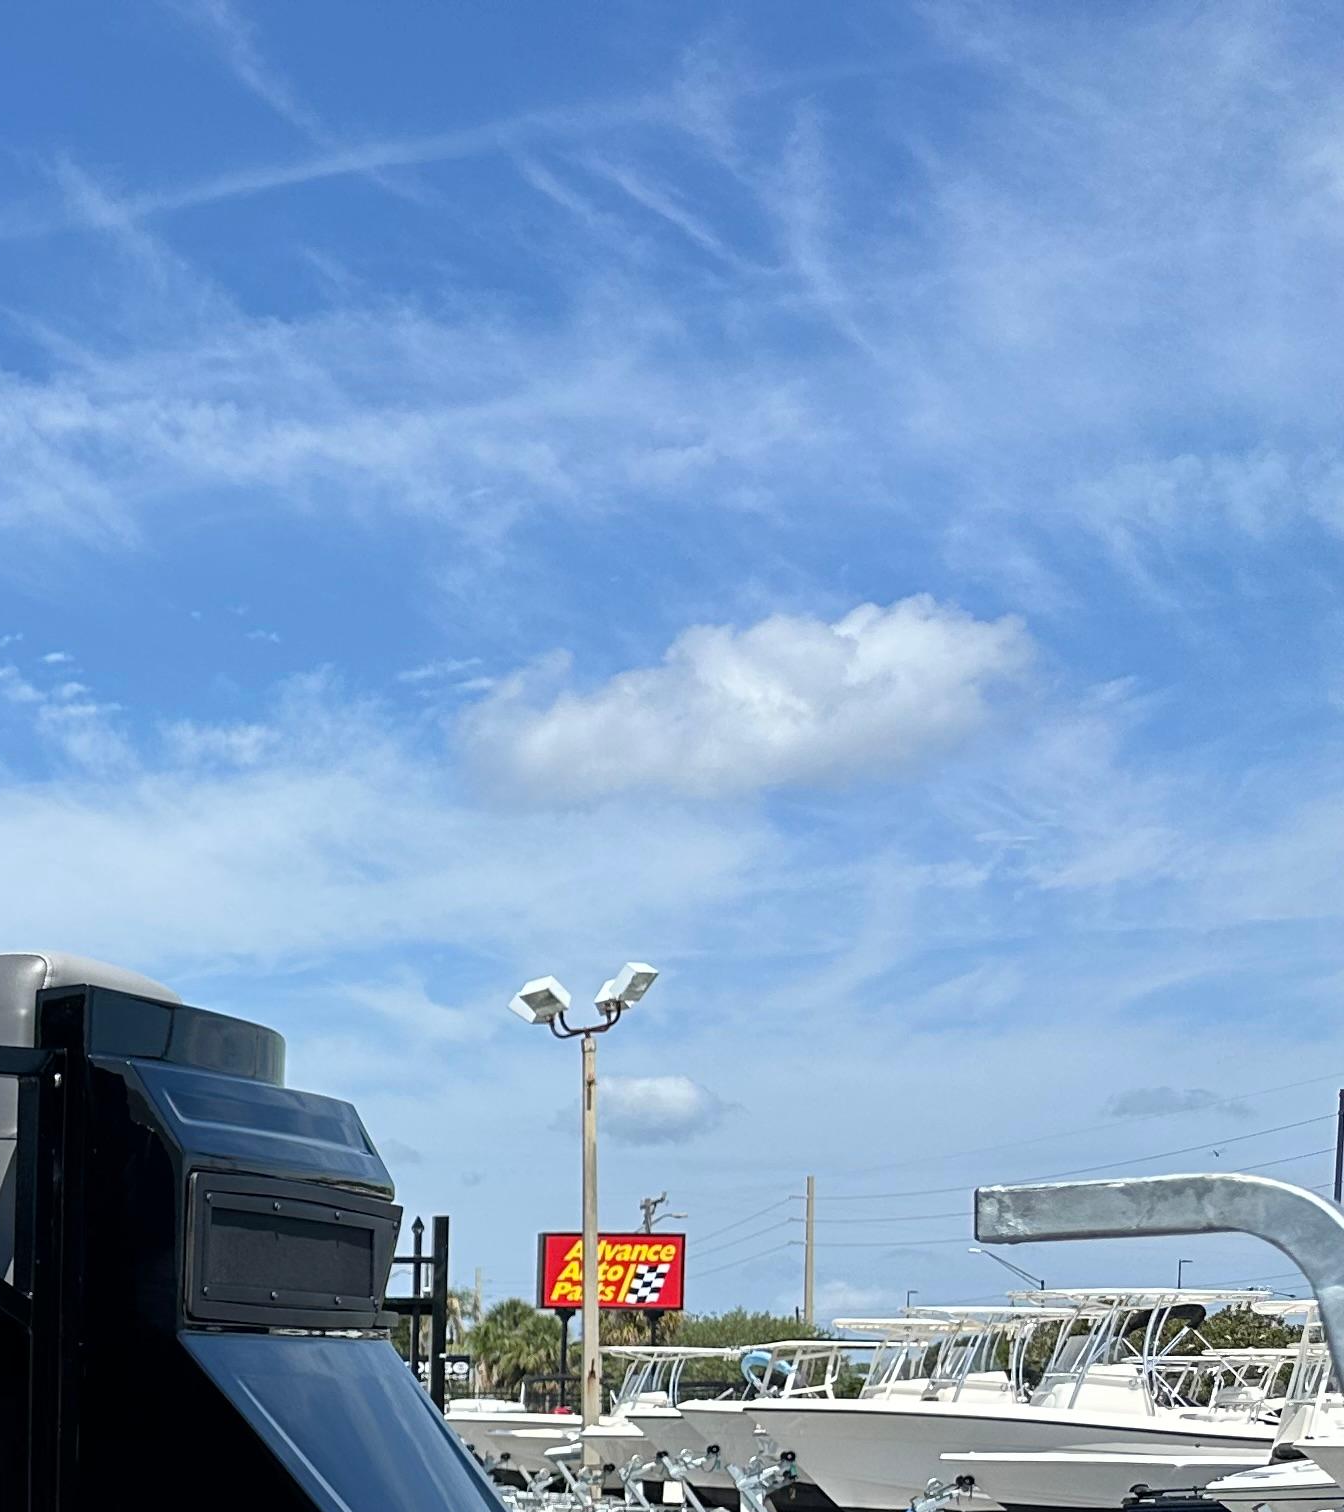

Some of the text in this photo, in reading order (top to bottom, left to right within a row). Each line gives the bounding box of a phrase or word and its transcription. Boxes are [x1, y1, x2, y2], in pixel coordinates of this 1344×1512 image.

[563, 1240, 676, 1261] Avance
[557, 1261, 624, 1281] Ato
[550, 1281, 616, 1302] Pats
